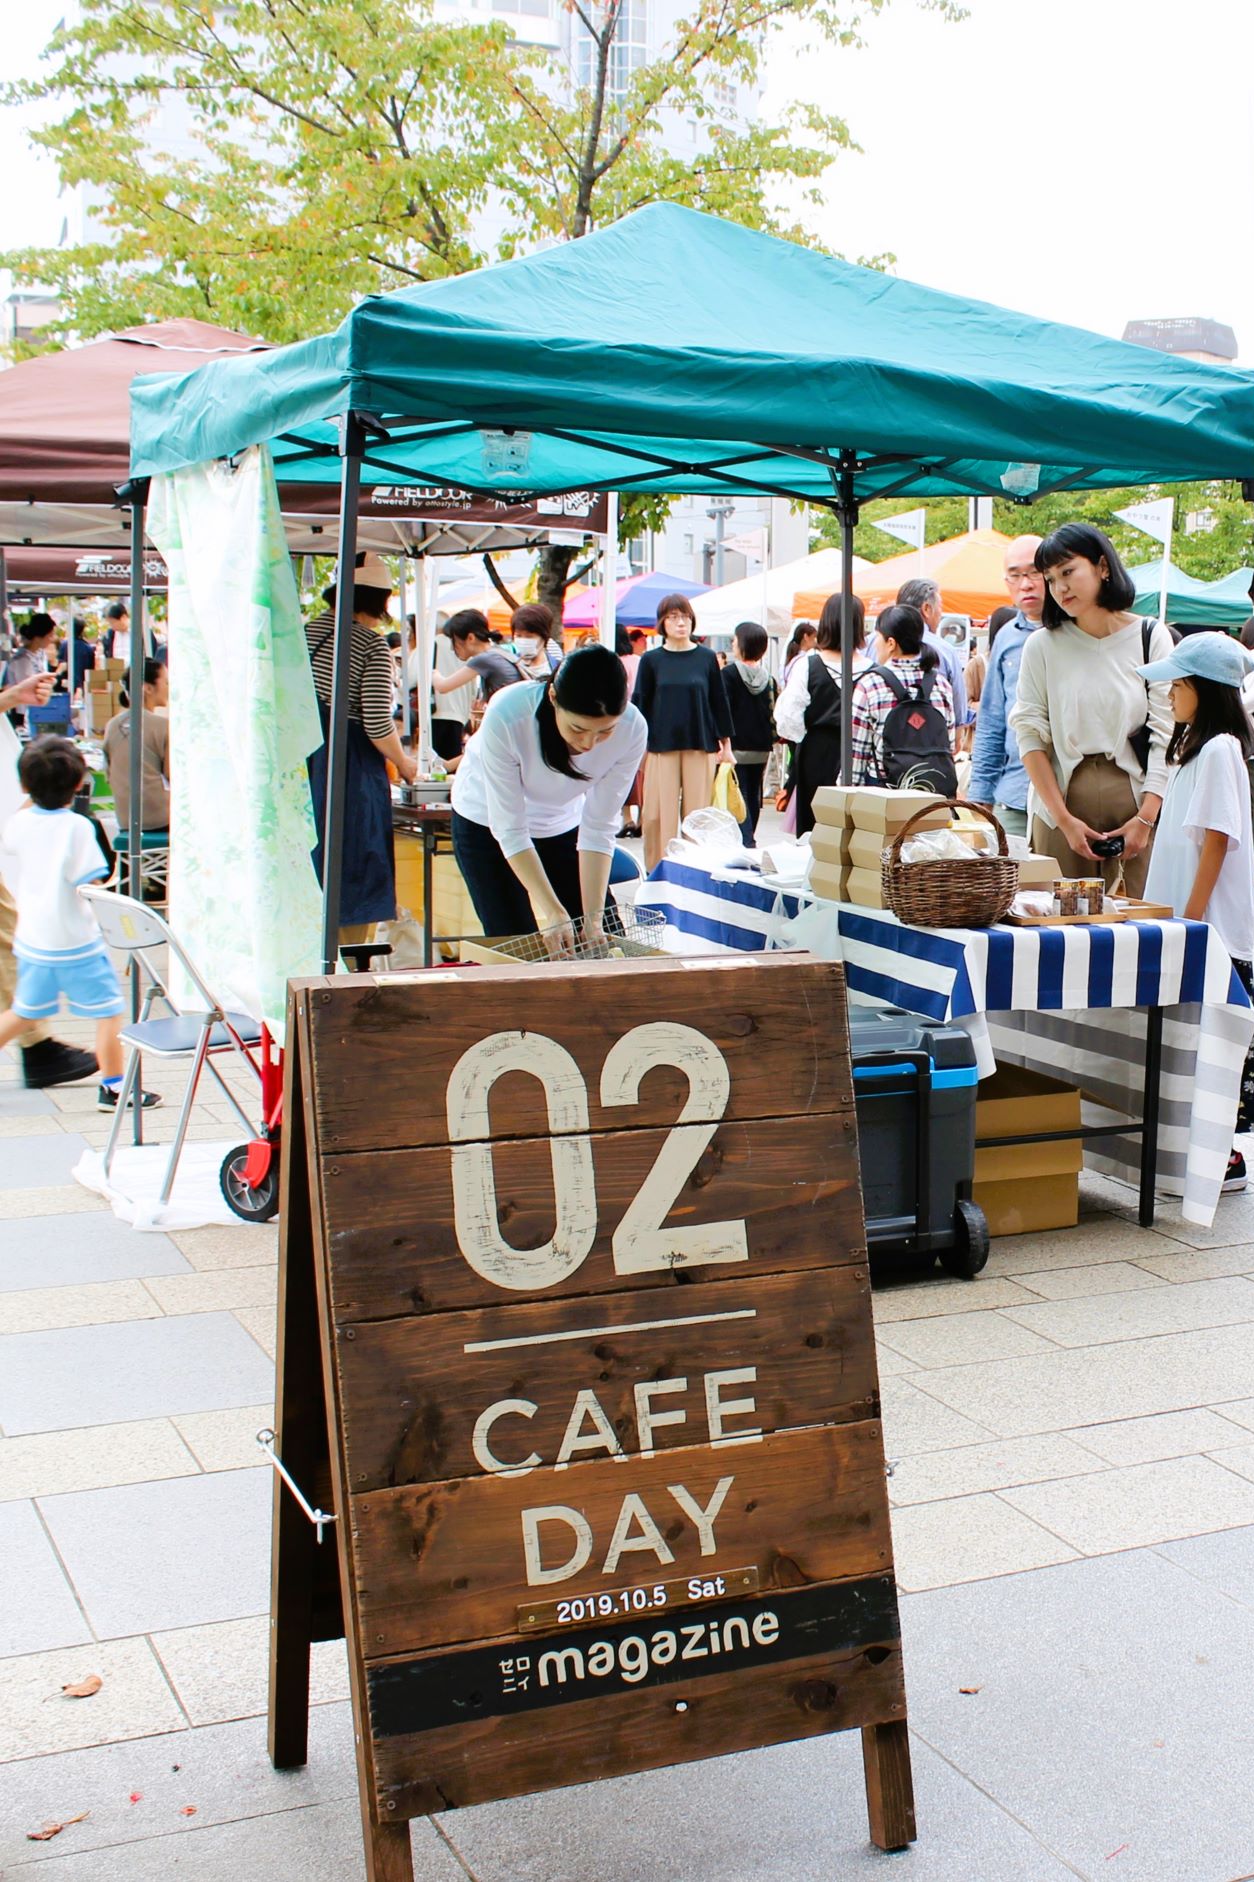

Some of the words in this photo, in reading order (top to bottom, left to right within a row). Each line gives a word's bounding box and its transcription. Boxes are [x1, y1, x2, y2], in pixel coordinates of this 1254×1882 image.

[371, 496, 409, 506] Powered
[412, 498, 423, 508] by
[88, 564, 131, 573] FIELDOO
[446, 1021, 748, 1291] 02
[472, 1366, 763, 1479] CAFE
[520, 1476, 735, 1586] DAY
[556, 1585, 667, 1624] 2019.10.5
[687, 1576, 726, 1600] Sat
[537, 1611, 780, 1687] magazine
